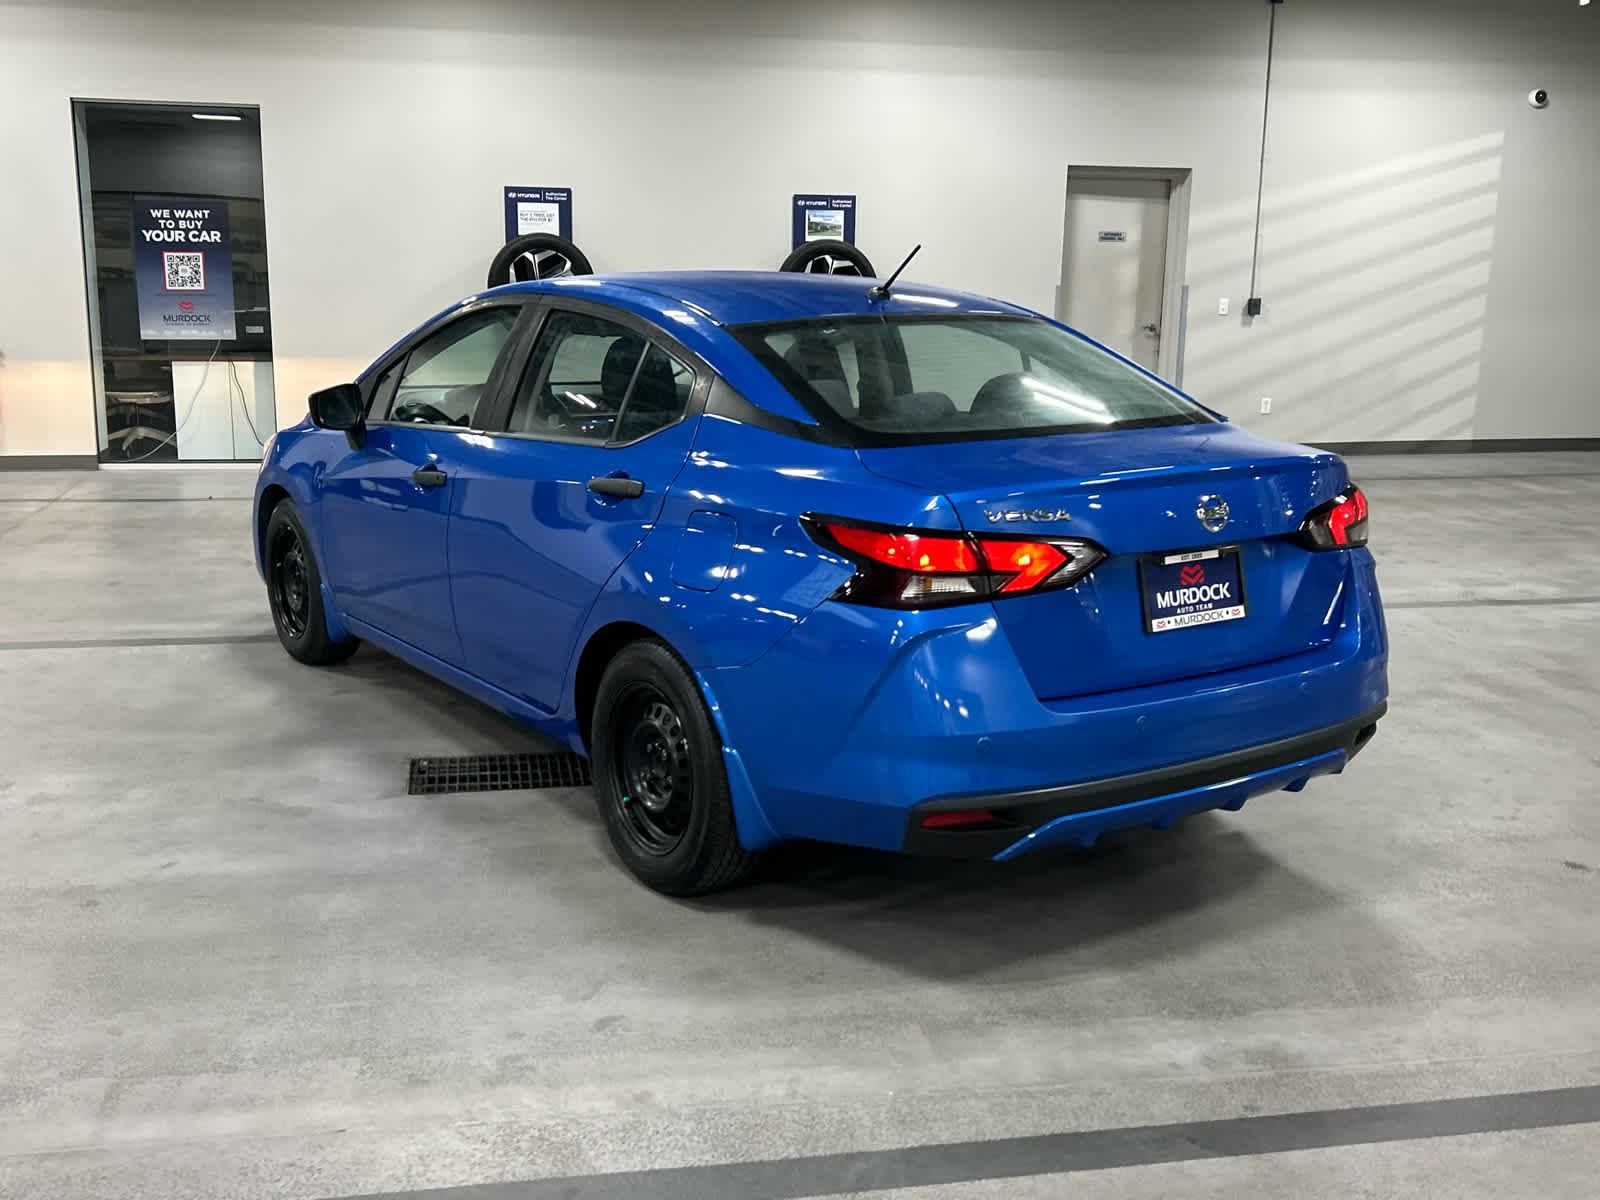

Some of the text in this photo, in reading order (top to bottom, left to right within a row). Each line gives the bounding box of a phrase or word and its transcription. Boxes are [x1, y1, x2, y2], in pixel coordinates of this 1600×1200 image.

[150, 209, 210, 219] WE WANT
[158, 220, 203, 229] TO BUY
[142, 230, 221, 243] YOUR CAR
[162, 314, 211, 322] MURDOCK
[983, 508, 1071, 523] VERSA
[1156, 581, 1231, 609] MURDOCK
[1176, 602, 1213, 614] AUTO TEAM
[1174, 610, 1224, 626] MURDOCK
